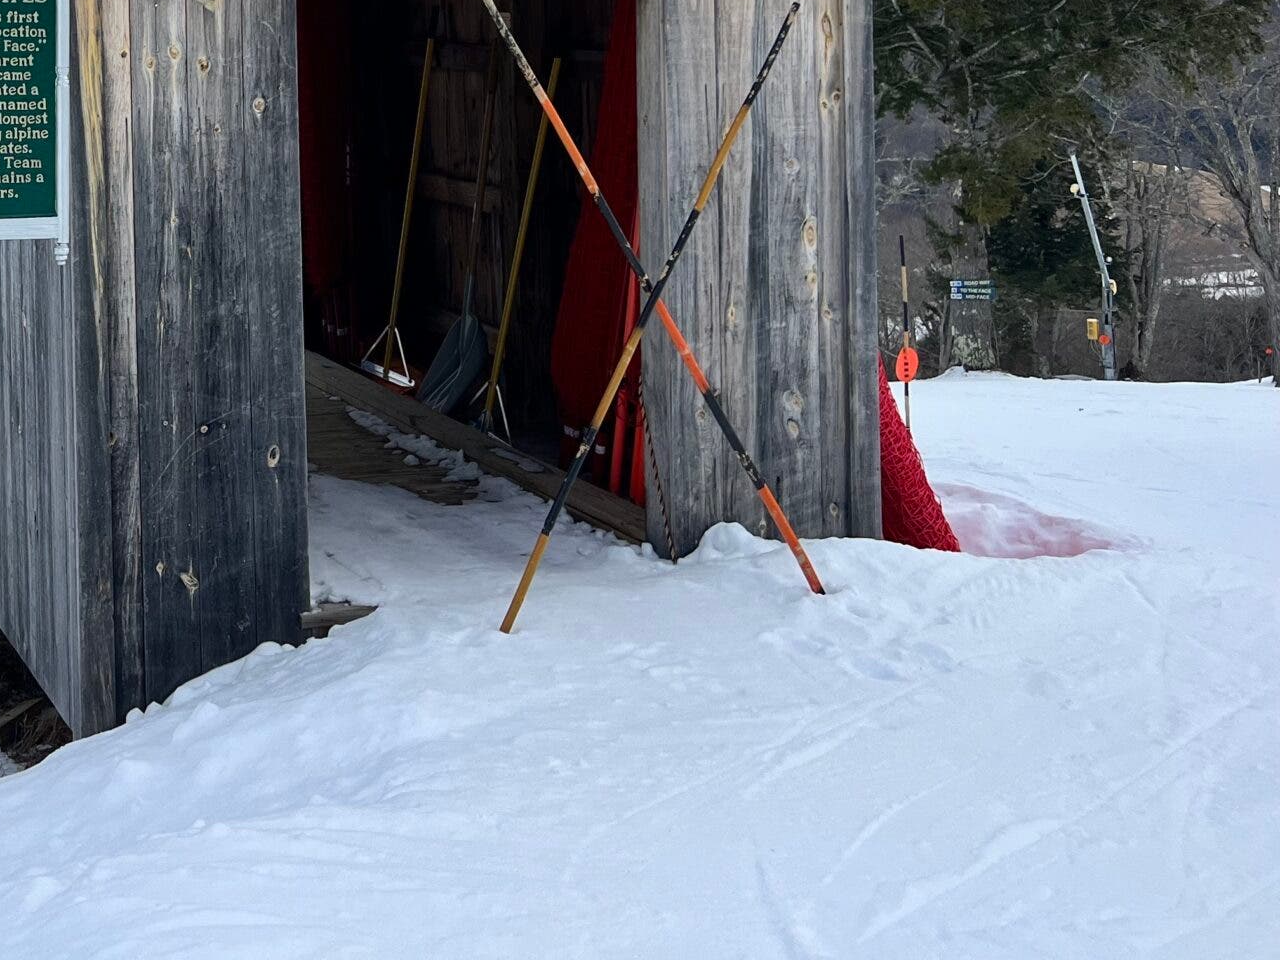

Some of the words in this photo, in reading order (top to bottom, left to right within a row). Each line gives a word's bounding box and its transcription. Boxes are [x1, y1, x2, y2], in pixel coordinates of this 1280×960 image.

[6, 10, 39, 23] first
[30, 86, 38, 95] a
[5, 126, 48, 142] alpine
[3, 155, 41, 169] Team
[36, 173, 44, 182] a
